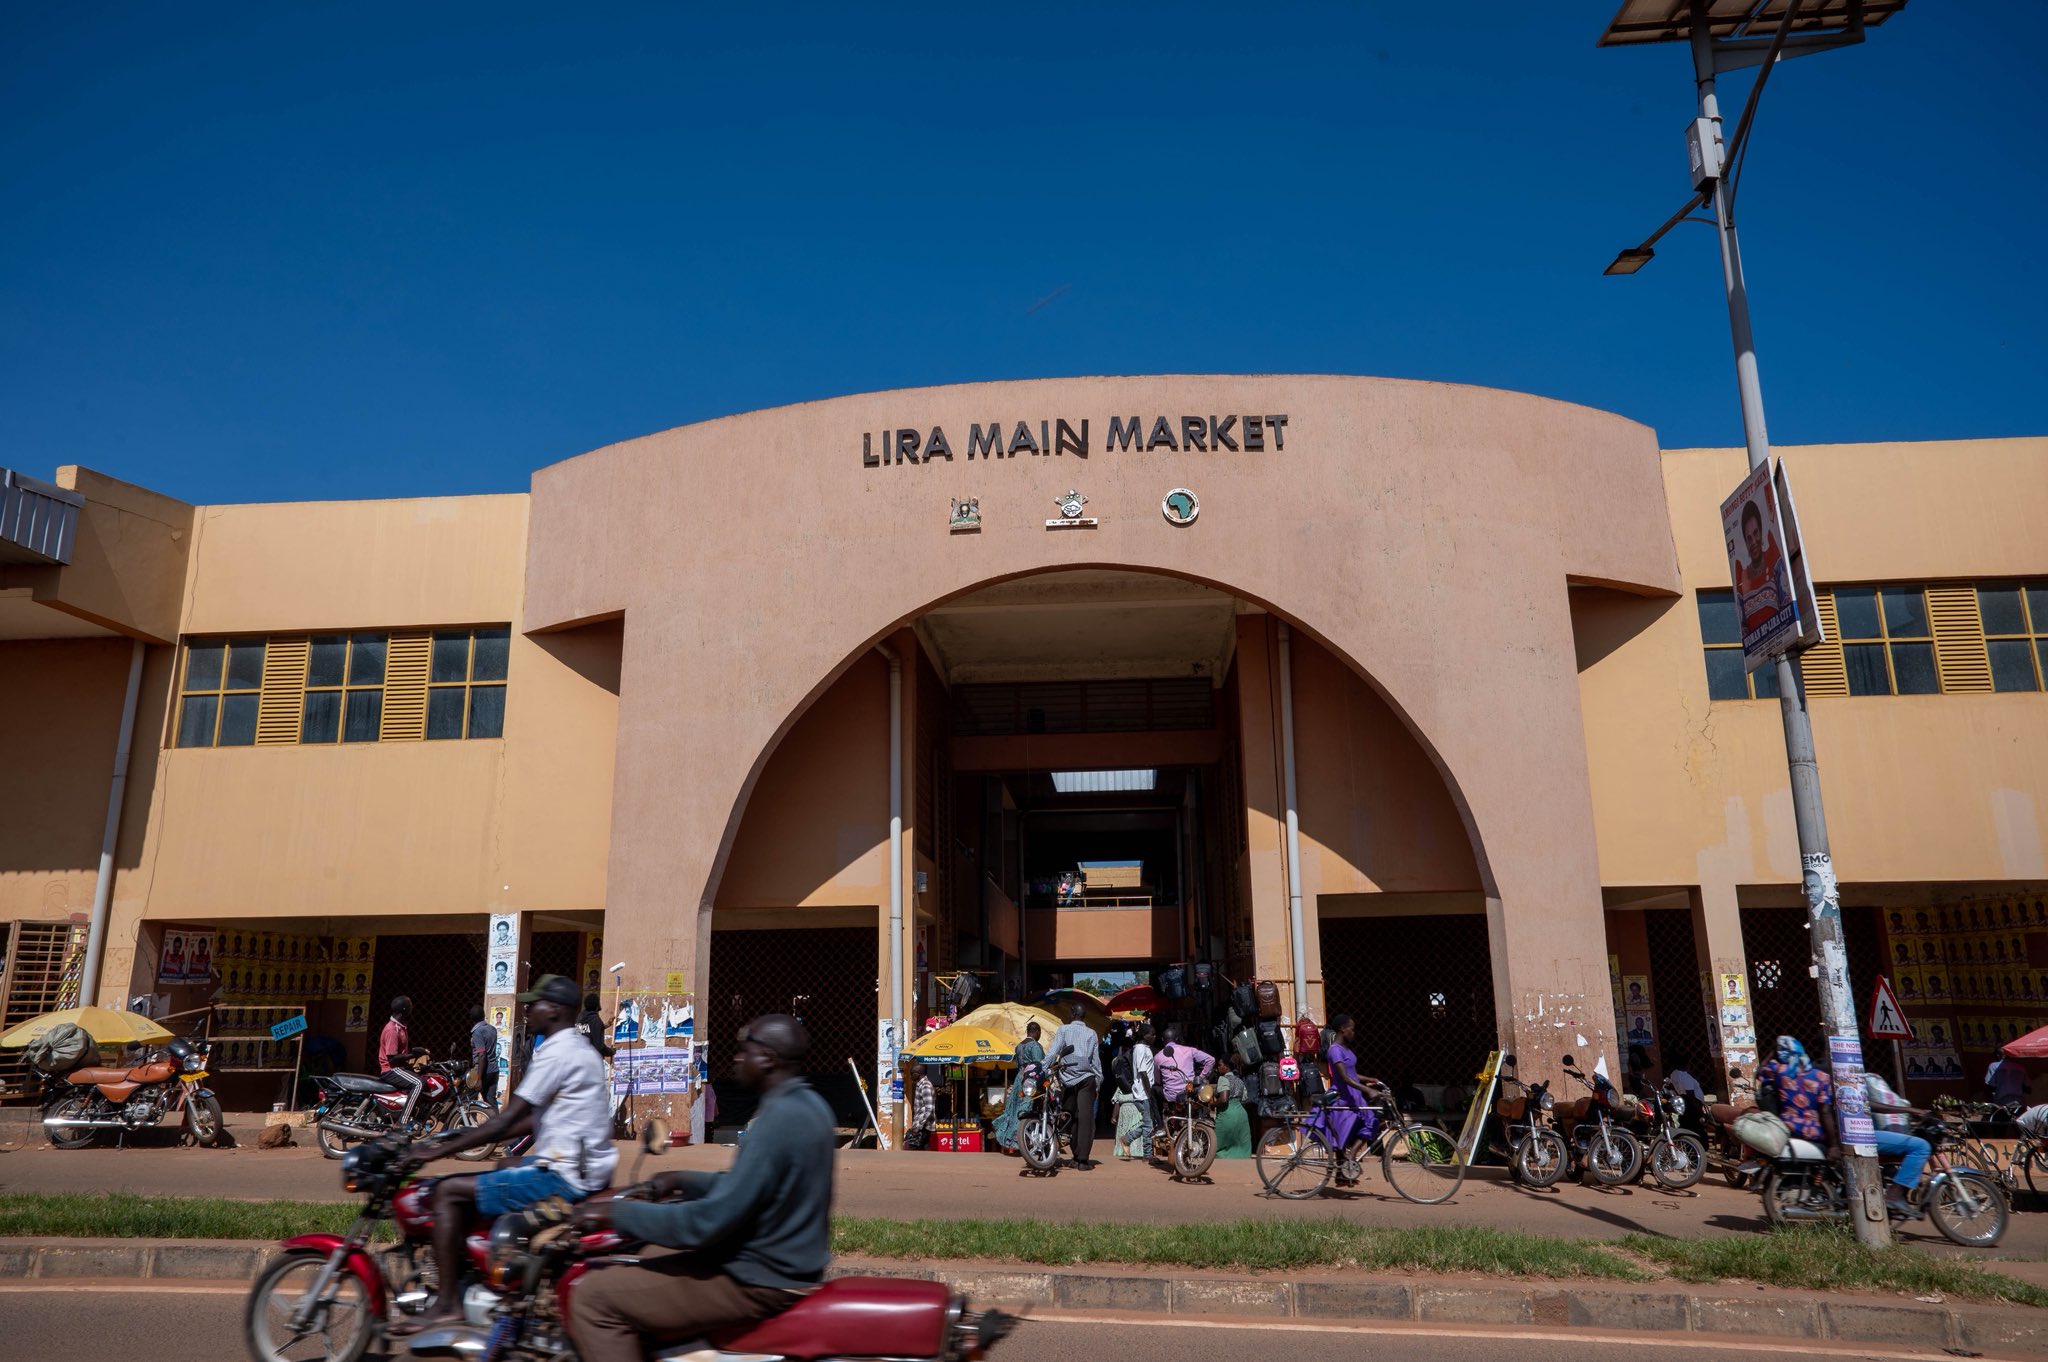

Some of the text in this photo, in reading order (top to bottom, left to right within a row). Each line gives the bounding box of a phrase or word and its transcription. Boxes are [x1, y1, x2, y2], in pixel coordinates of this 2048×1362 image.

[862, 414, 1288, 468] LIRA MAIN MARKET
[1779, 604, 1792, 622] CITY
[274, 1020, 302, 1038] REPAIR
[949, 1137, 970, 1145] atel
